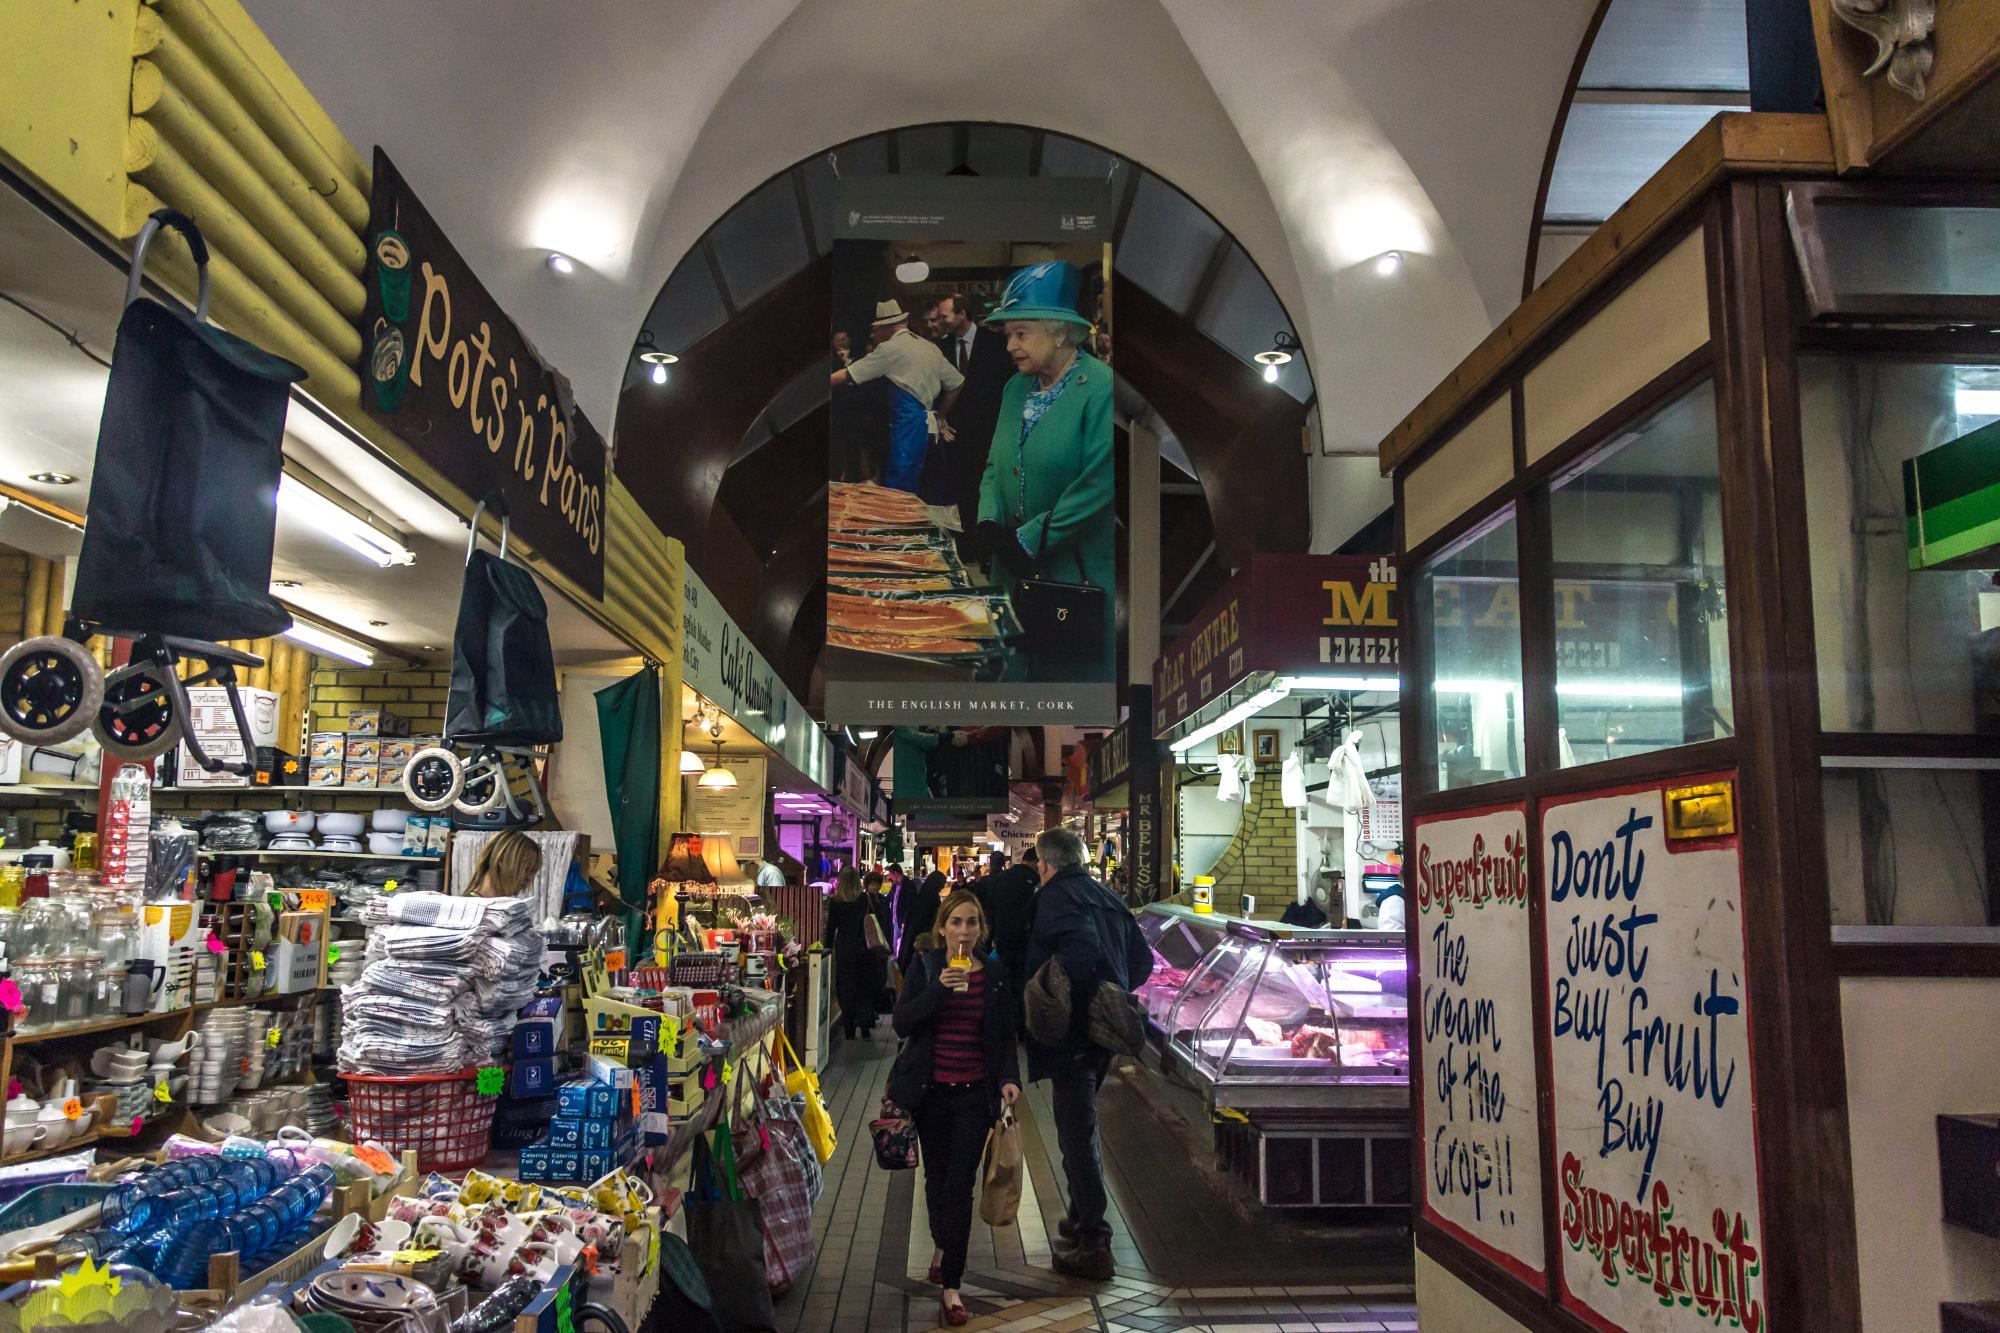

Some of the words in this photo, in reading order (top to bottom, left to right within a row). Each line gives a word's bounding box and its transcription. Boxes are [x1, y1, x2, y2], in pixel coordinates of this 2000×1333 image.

[720, 621, 744, 715] Café
[1190, 599, 1240, 678] CENTRE
[868, 700, 895, 710] THE
[901, 700, 962, 710] ENGLISH
[969, 700, 1030, 711] MARKET,
[1037, 701, 1075, 710] CORK
[993, 820, 1010, 829] The
[1001, 830, 1035, 839] Chicken
[1551, 807, 1653, 903] Dont
[1418, 832, 1528, 918] Superfruit
[1433, 921, 1469, 987] The
[1424, 984, 1501, 1052] Cream
[1554, 977, 1610, 1089] Buy
[1437, 1043, 1459, 1123] of
[1598, 1078, 1664, 1205] Buy
[1562, 1151, 1765, 1333] Superfruit
